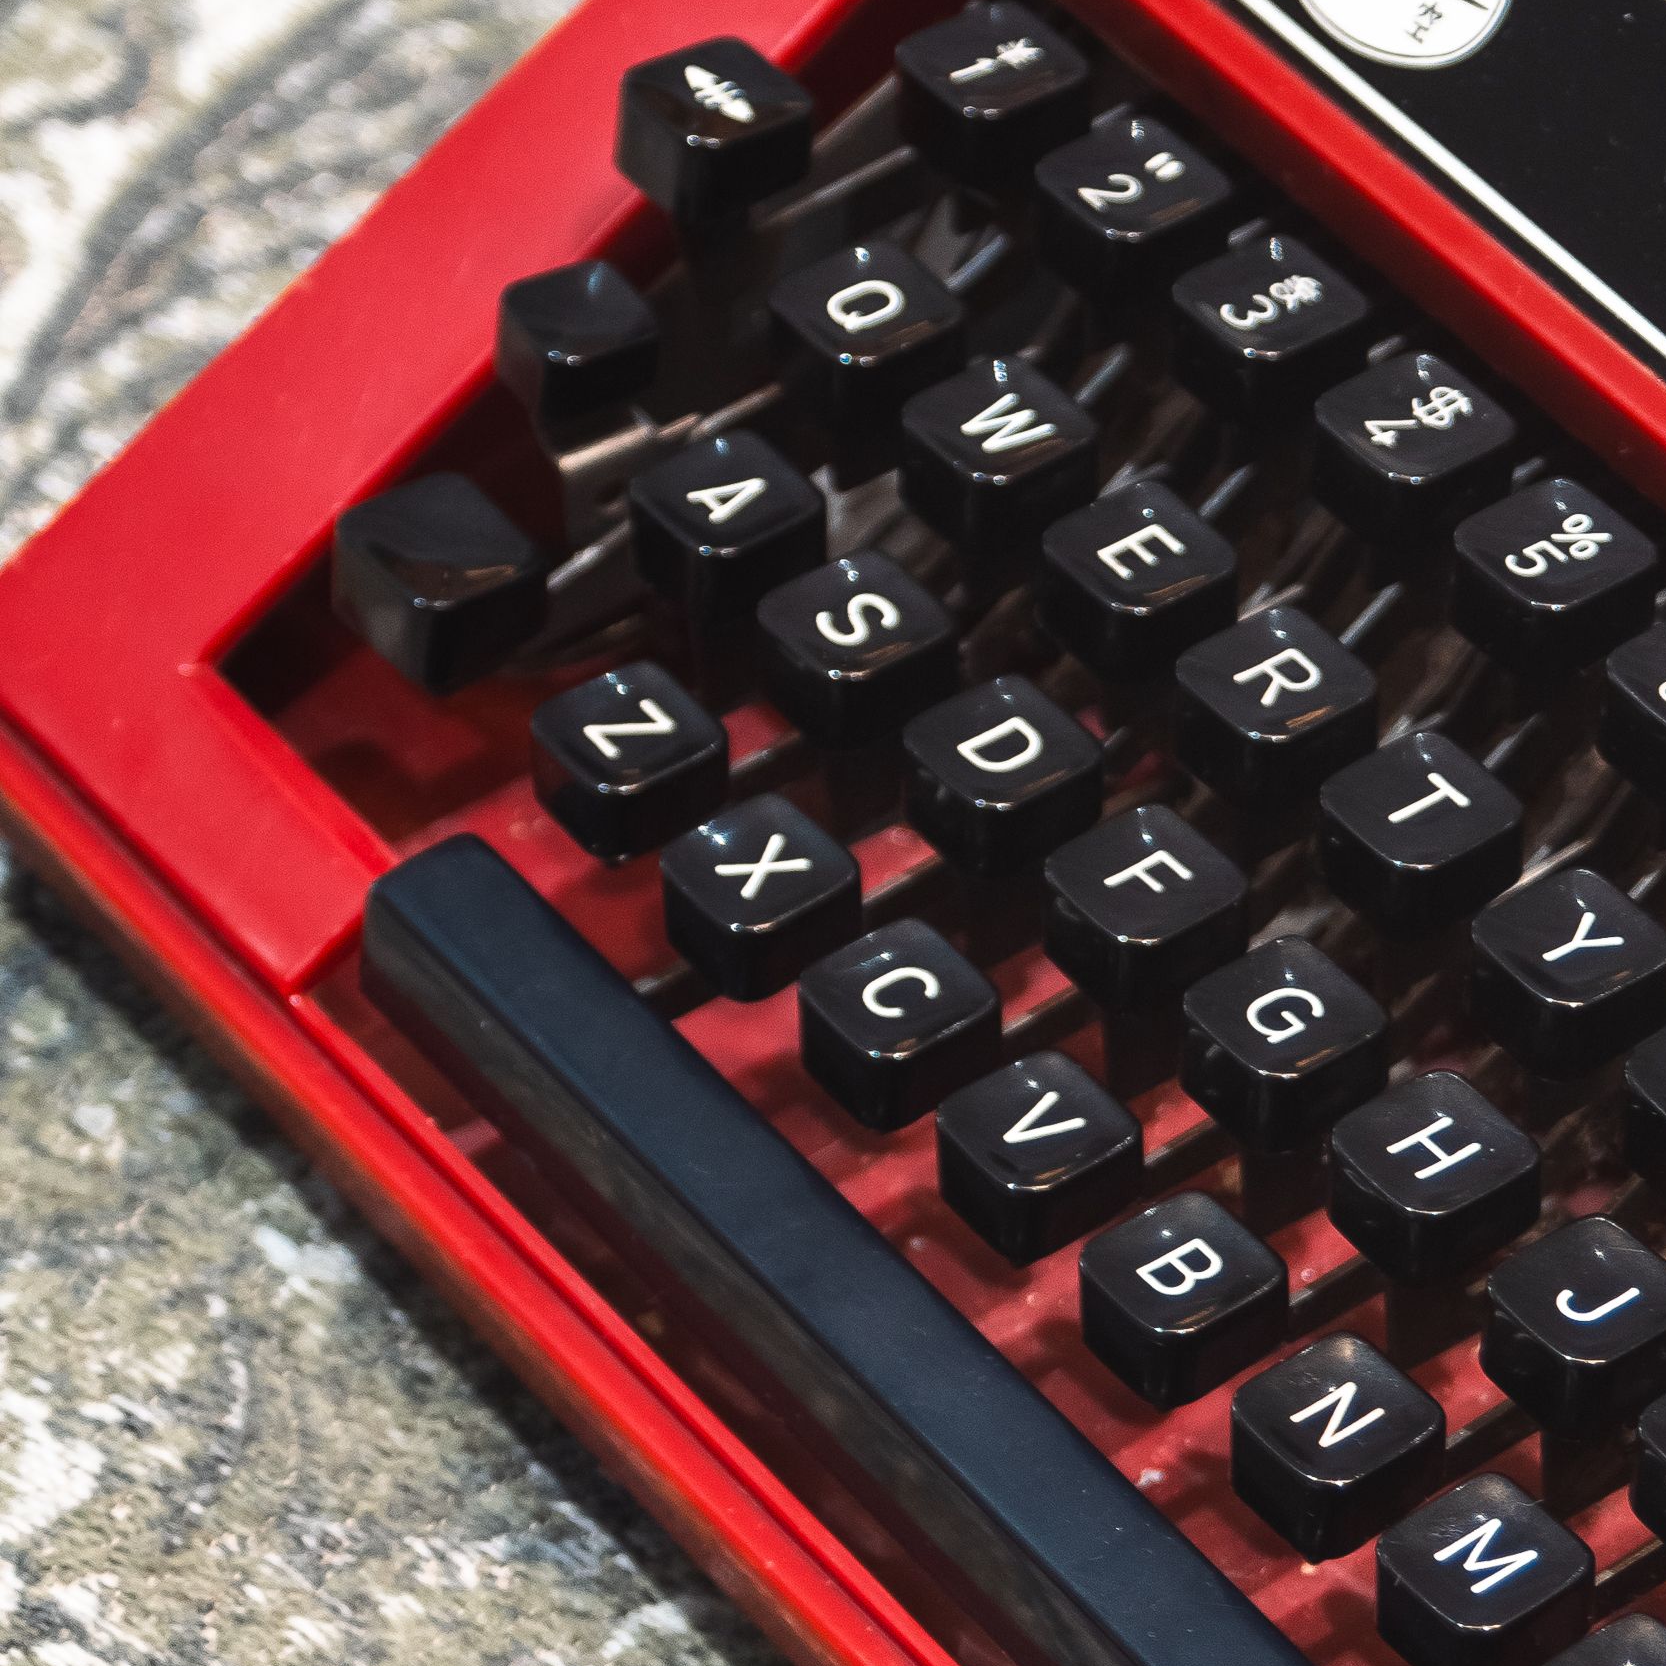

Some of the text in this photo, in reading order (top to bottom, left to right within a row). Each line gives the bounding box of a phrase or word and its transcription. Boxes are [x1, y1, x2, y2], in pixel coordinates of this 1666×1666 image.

[1077, 173, 1143, 210] 2
[826, 279, 904, 332] Q
[1219, 293, 1278, 331] 3
[960, 392, 1054, 452] W
[1363, 418, 1416, 448] 4
[1411, 386, 1473, 429] $
[686, 477, 766, 523] A
[1096, 523, 1184, 580] E
[1504, 537, 1569, 577] 5
[1550, 513, 1613, 562] %
[815, 593, 899, 646] S
[1232, 647, 1322, 707] R
[583, 698, 676, 758] Z
[956, 716, 1042, 773] D
[1387, 772, 1470, 824] T
[714, 833, 811, 899] X
[1103, 849, 1193, 893] F
[1542, 911, 1625, 962] Y
[861, 966, 940, 1018] C
[1246, 987, 1325, 1044] G
[1002, 1091, 1087, 1144] V
[1386, 1115, 1482, 1181] H
[1135, 1237, 1224, 1297] B
[1555, 1287, 1640, 1322] J
[1289, 1381, 1386, 1448] N
[1433, 1514, 1539, 1594] M
